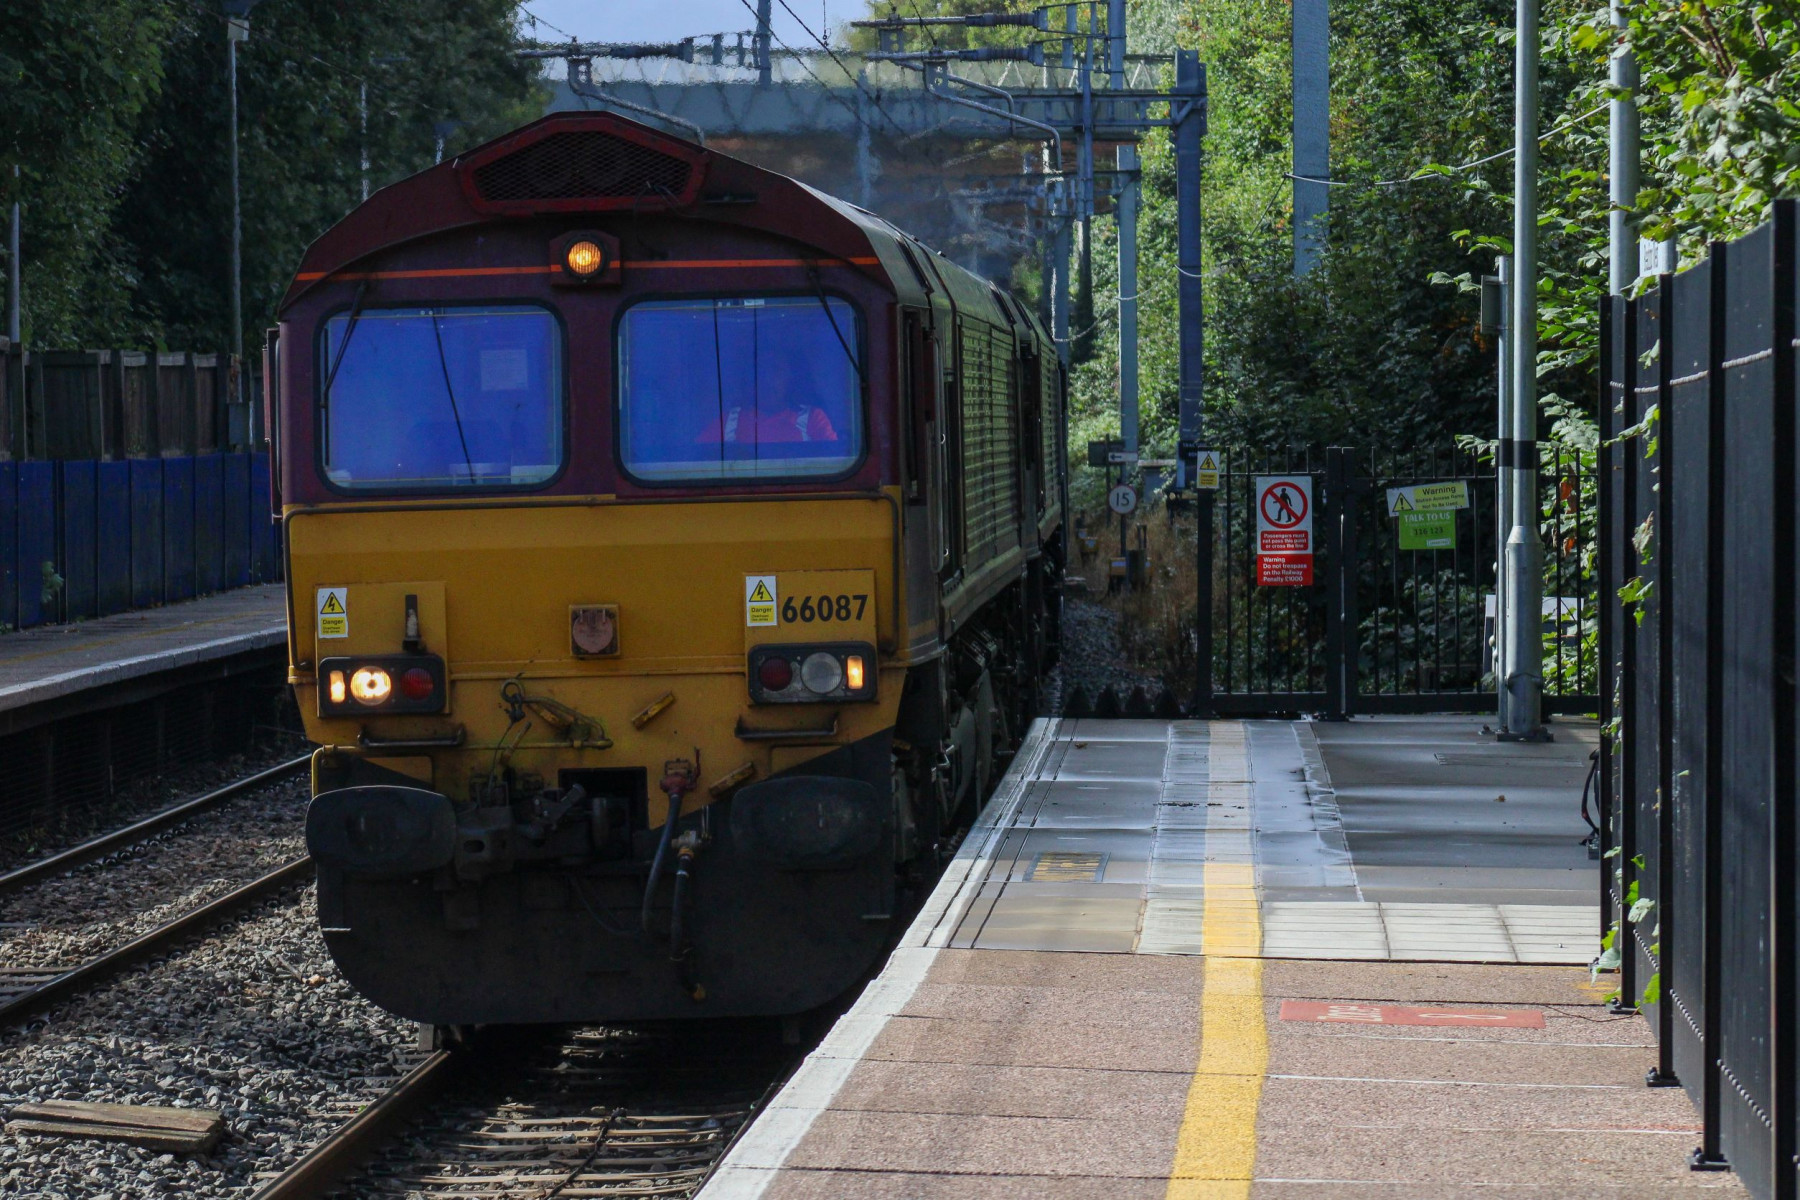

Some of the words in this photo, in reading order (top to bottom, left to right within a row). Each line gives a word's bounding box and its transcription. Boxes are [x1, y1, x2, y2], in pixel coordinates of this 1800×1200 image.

[1422, 486, 1456, 495] Warning
[1116, 493, 1130, 506] 15
[1404, 513, 1424, 523] TALK
[1426, 513, 1438, 522] TO
[1439, 512, 1450, 520] US
[782, 594, 868, 623] 66087
